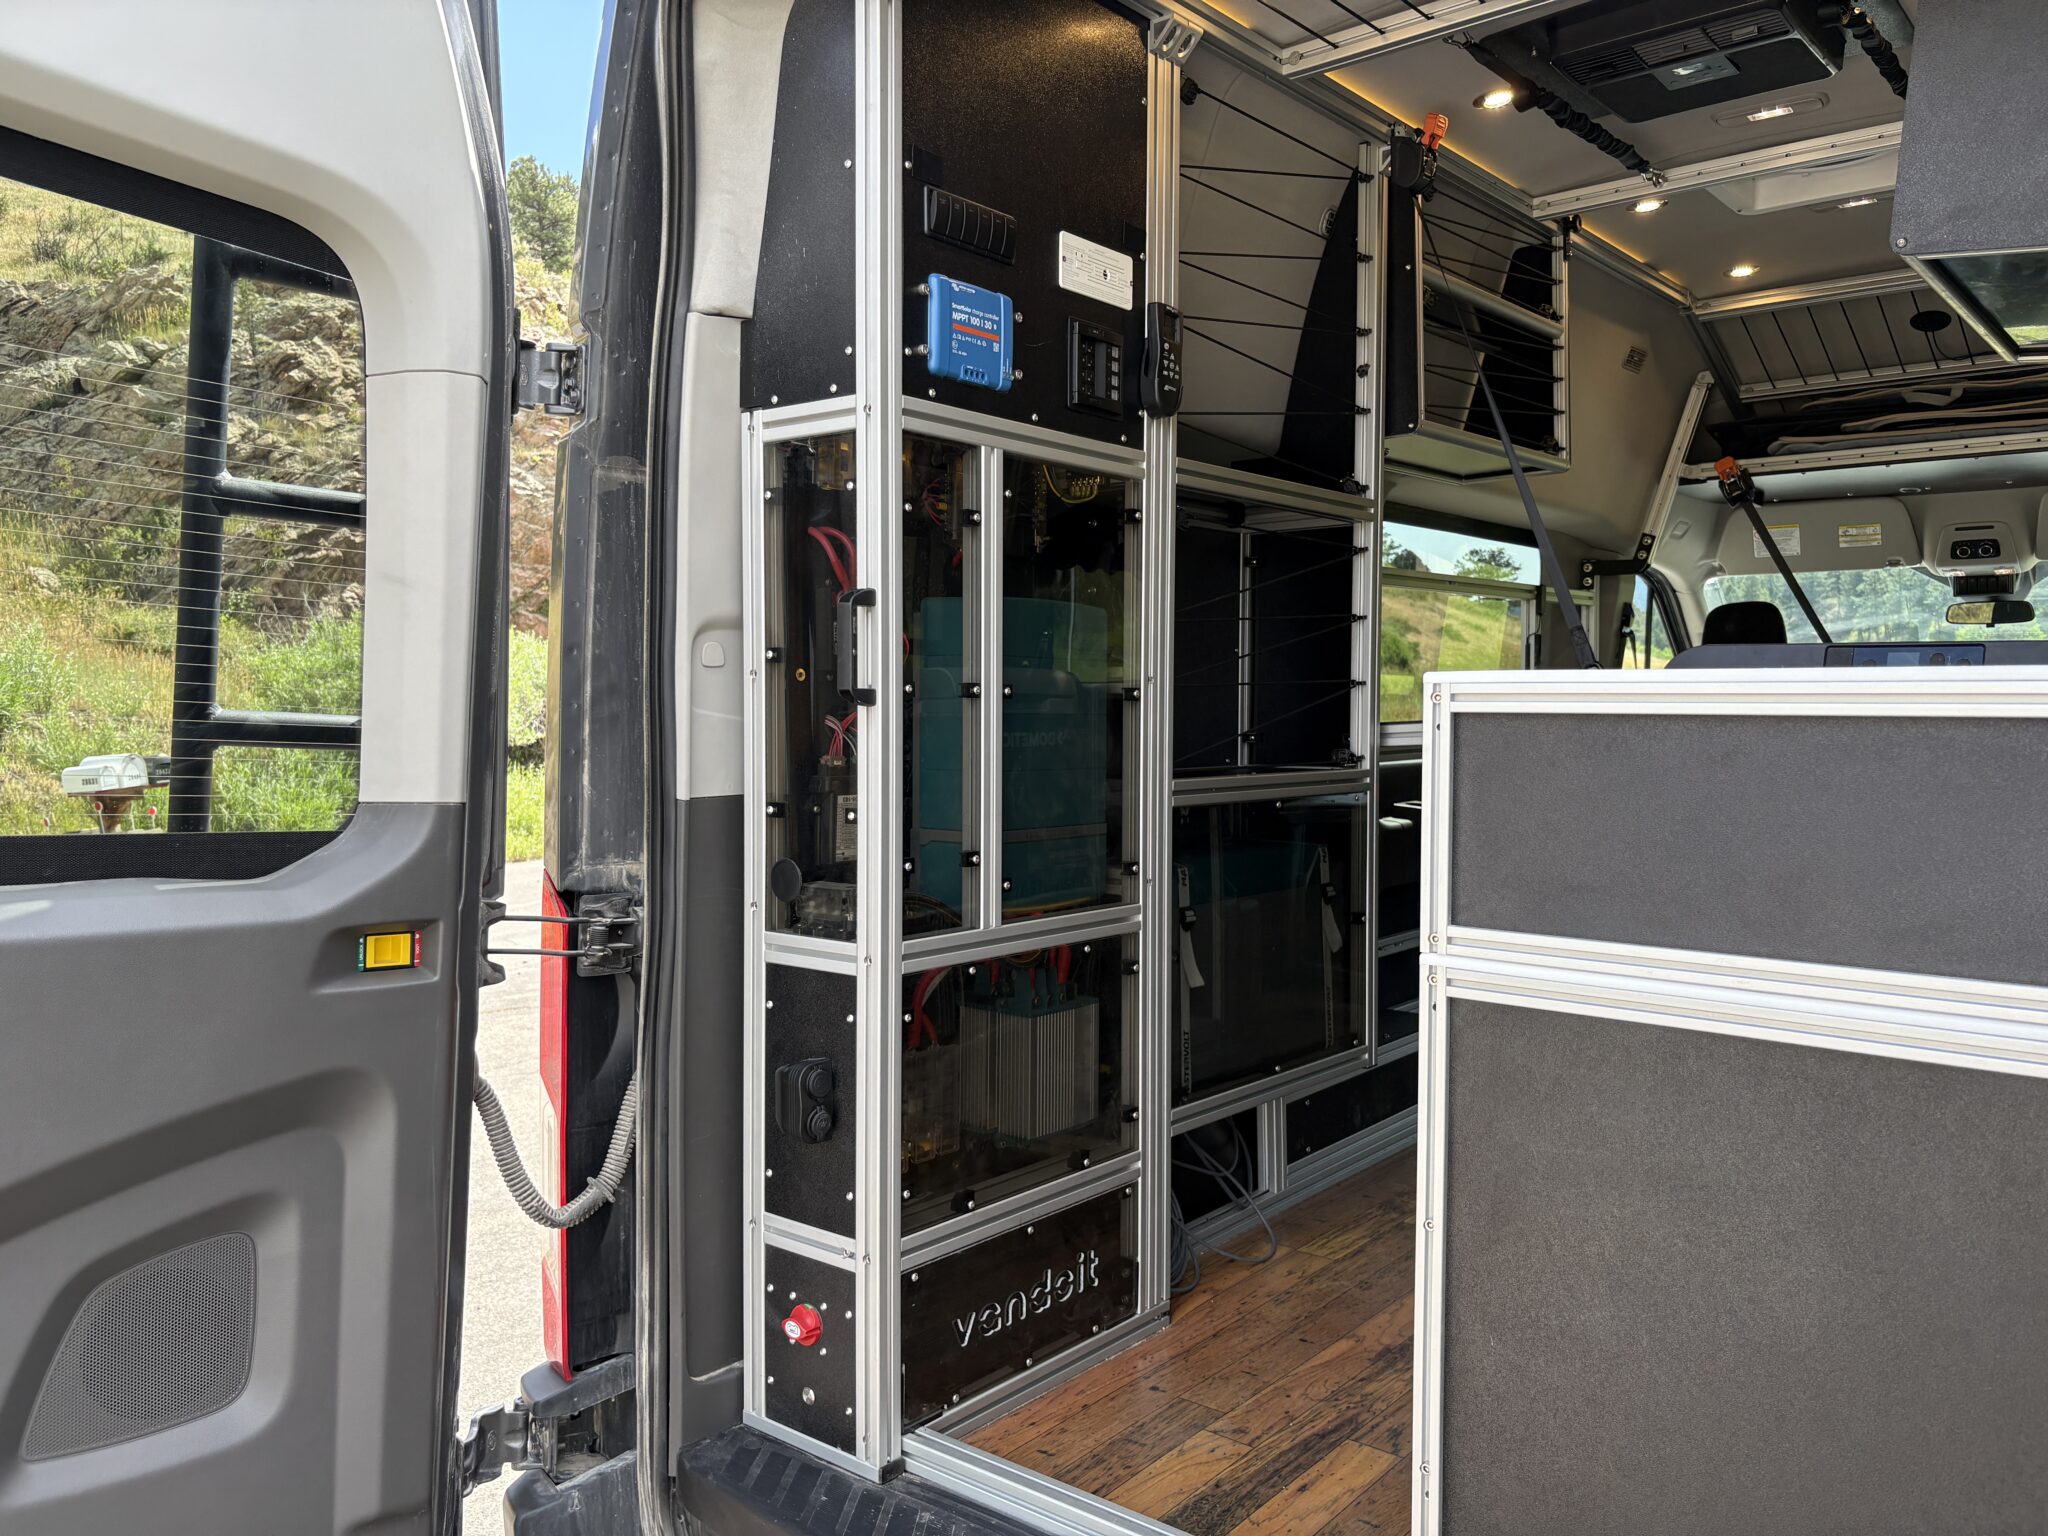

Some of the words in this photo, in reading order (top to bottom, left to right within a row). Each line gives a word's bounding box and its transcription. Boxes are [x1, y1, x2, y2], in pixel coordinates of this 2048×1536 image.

[952, 310, 969, 323] MPPT
[970, 315, 981, 327] 100
[984, 320, 993, 330] 30
[972, 308, 984, 318] charge
[984, 312, 1000, 321] controller
[952, 1249, 1100, 1348] vandoit
